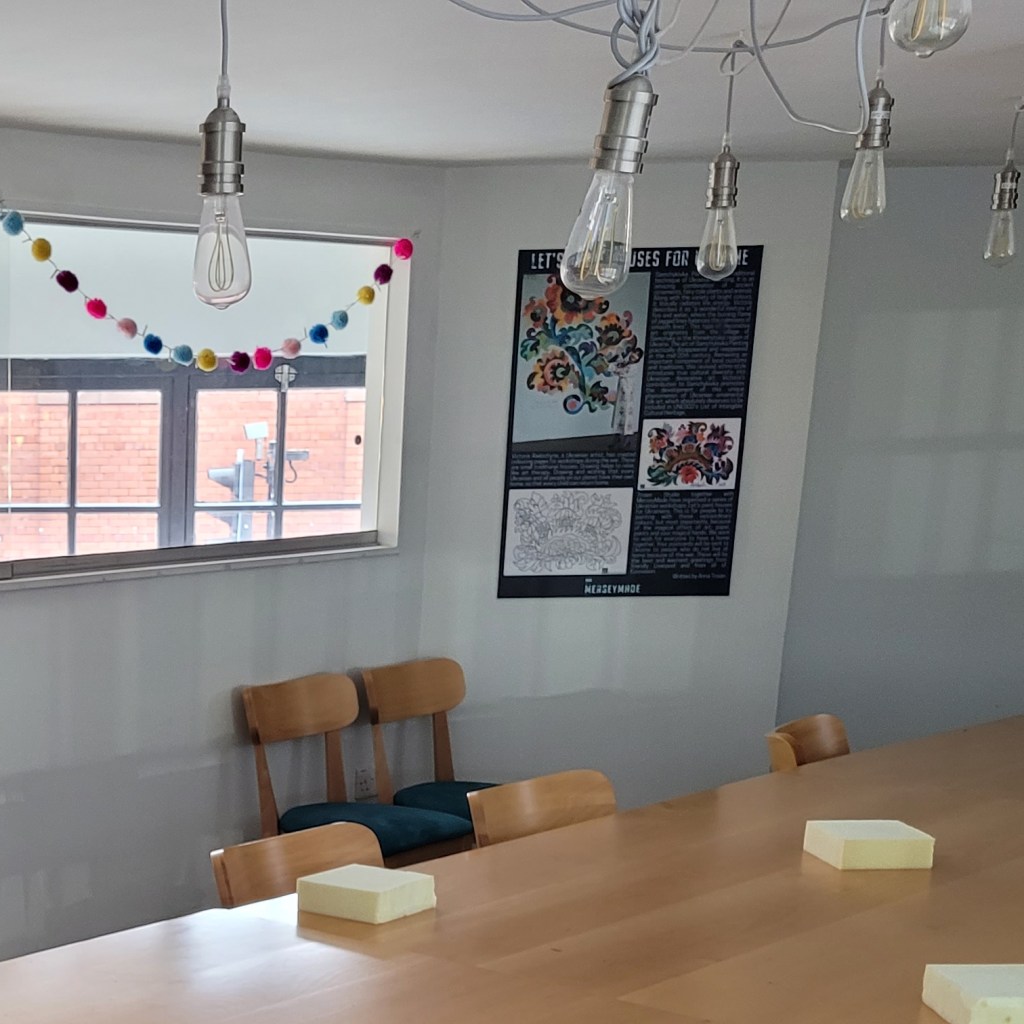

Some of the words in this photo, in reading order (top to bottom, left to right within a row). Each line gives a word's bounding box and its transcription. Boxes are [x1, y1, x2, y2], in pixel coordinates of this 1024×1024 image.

[531, 252, 563, 270] LET'S
[629, 250, 660, 268] USES
[665, 250, 689, 267] FOR
